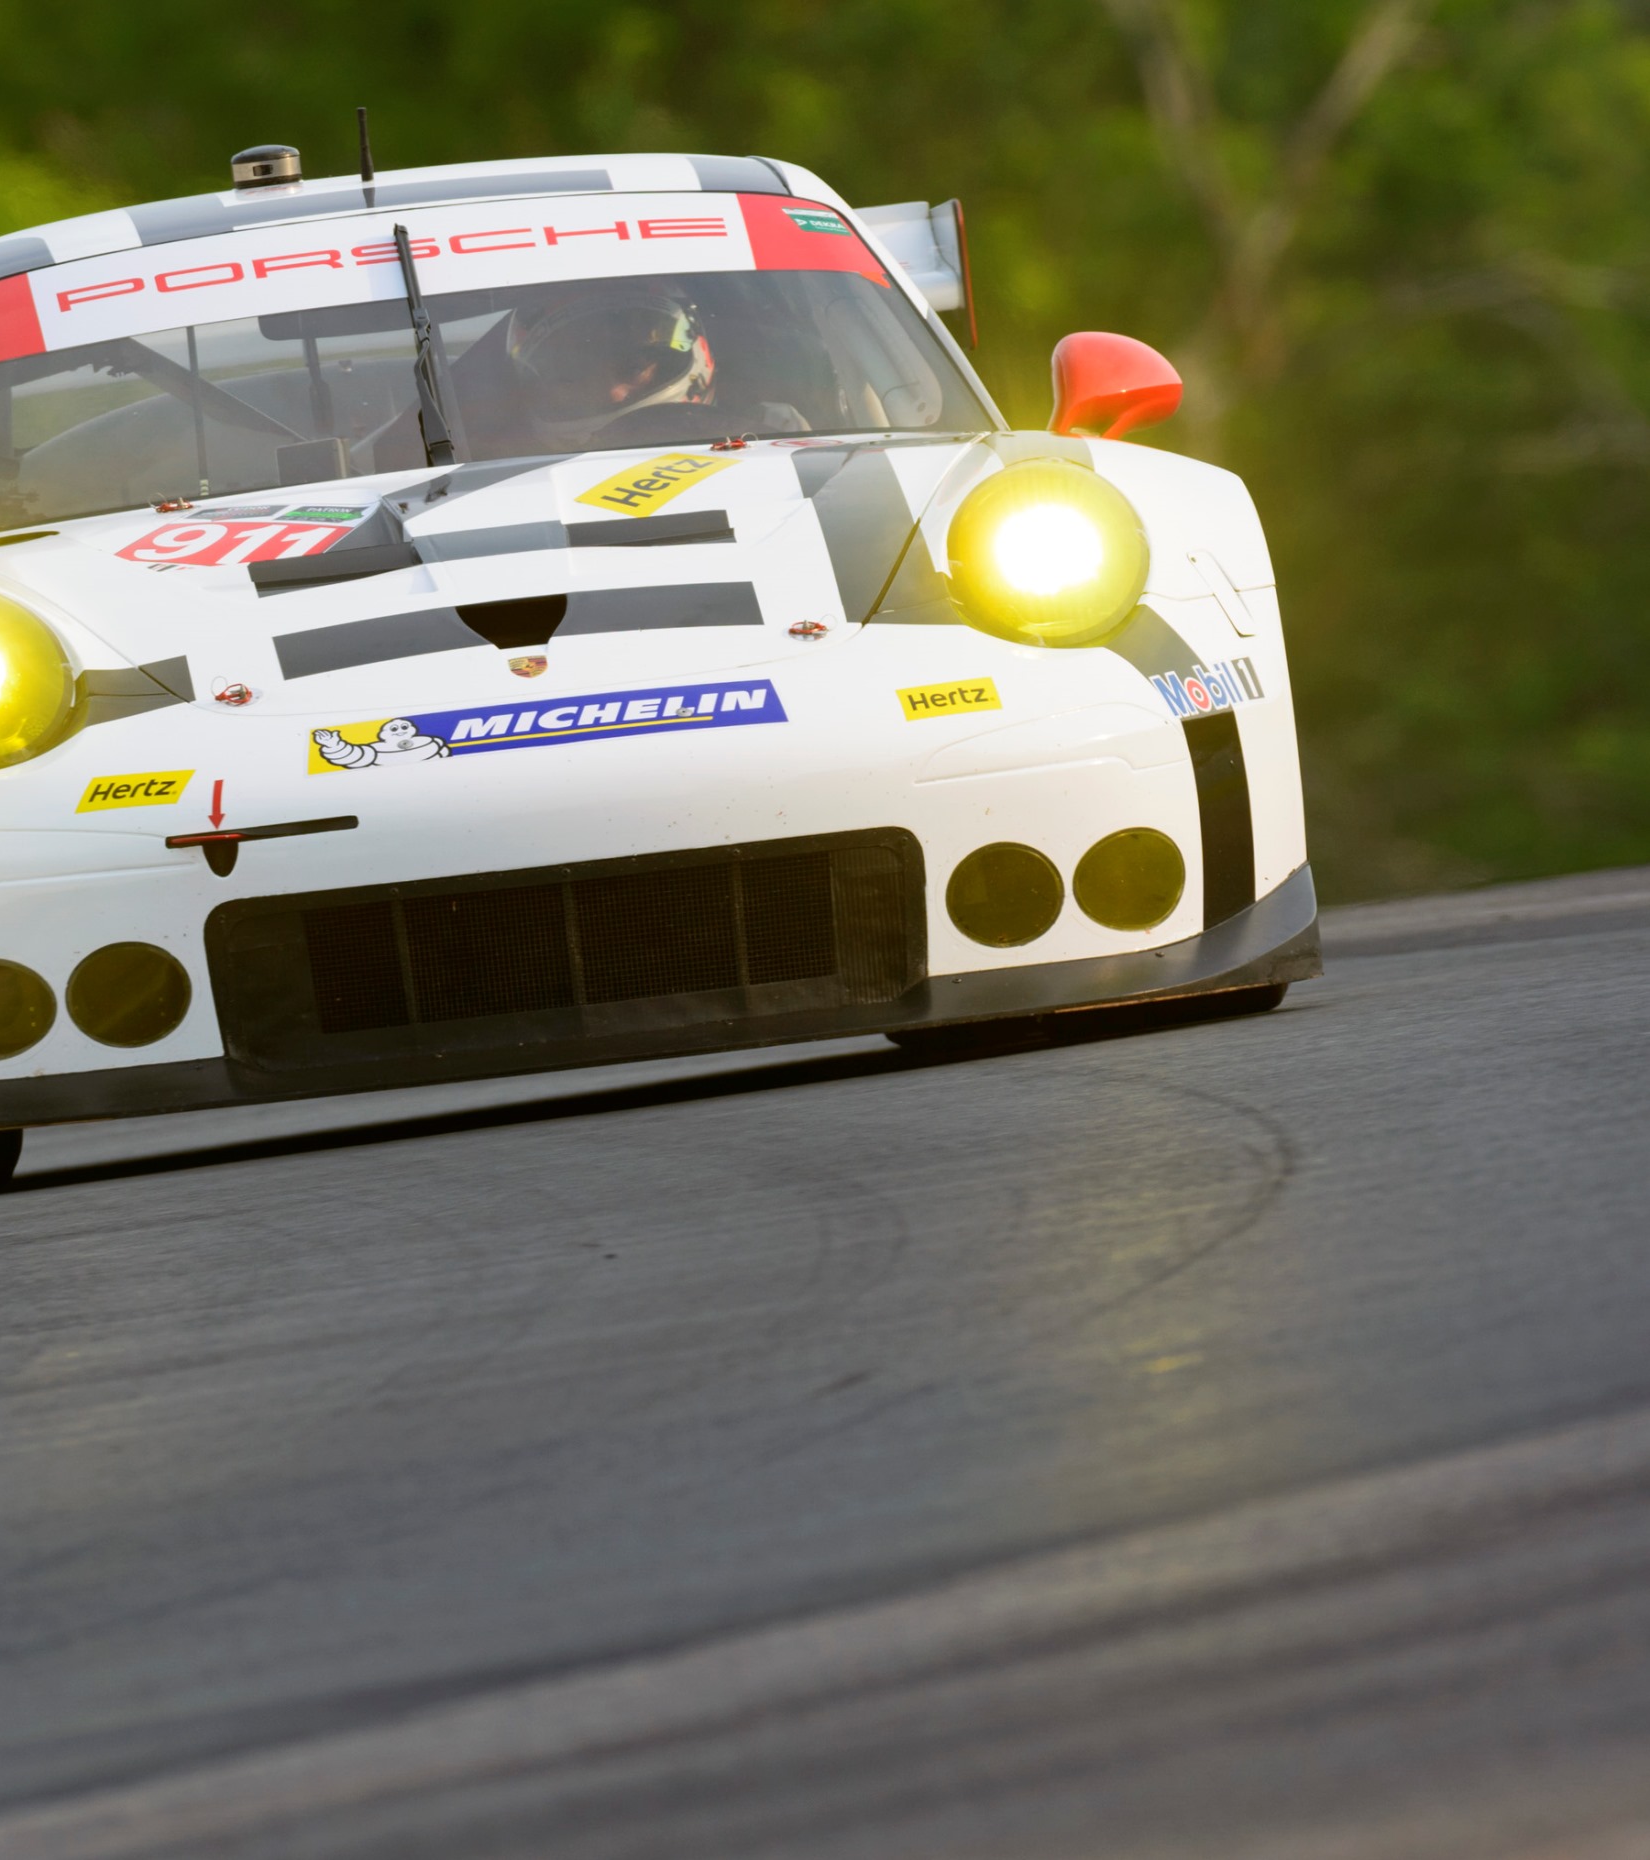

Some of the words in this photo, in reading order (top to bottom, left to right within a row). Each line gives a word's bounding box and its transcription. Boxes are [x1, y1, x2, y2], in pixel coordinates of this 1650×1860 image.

[56, 217, 728, 312] PORSCHE
[600, 458, 715, 507] Hertz
[133, 524, 337, 566] 911
[906, 687, 990, 712] Hertz
[1149, 661, 1244, 717] Mobil
[1236, 658, 1260, 699] 1
[450, 688, 768, 741] MICHELIN
[88, 778, 178, 803] Hertz
